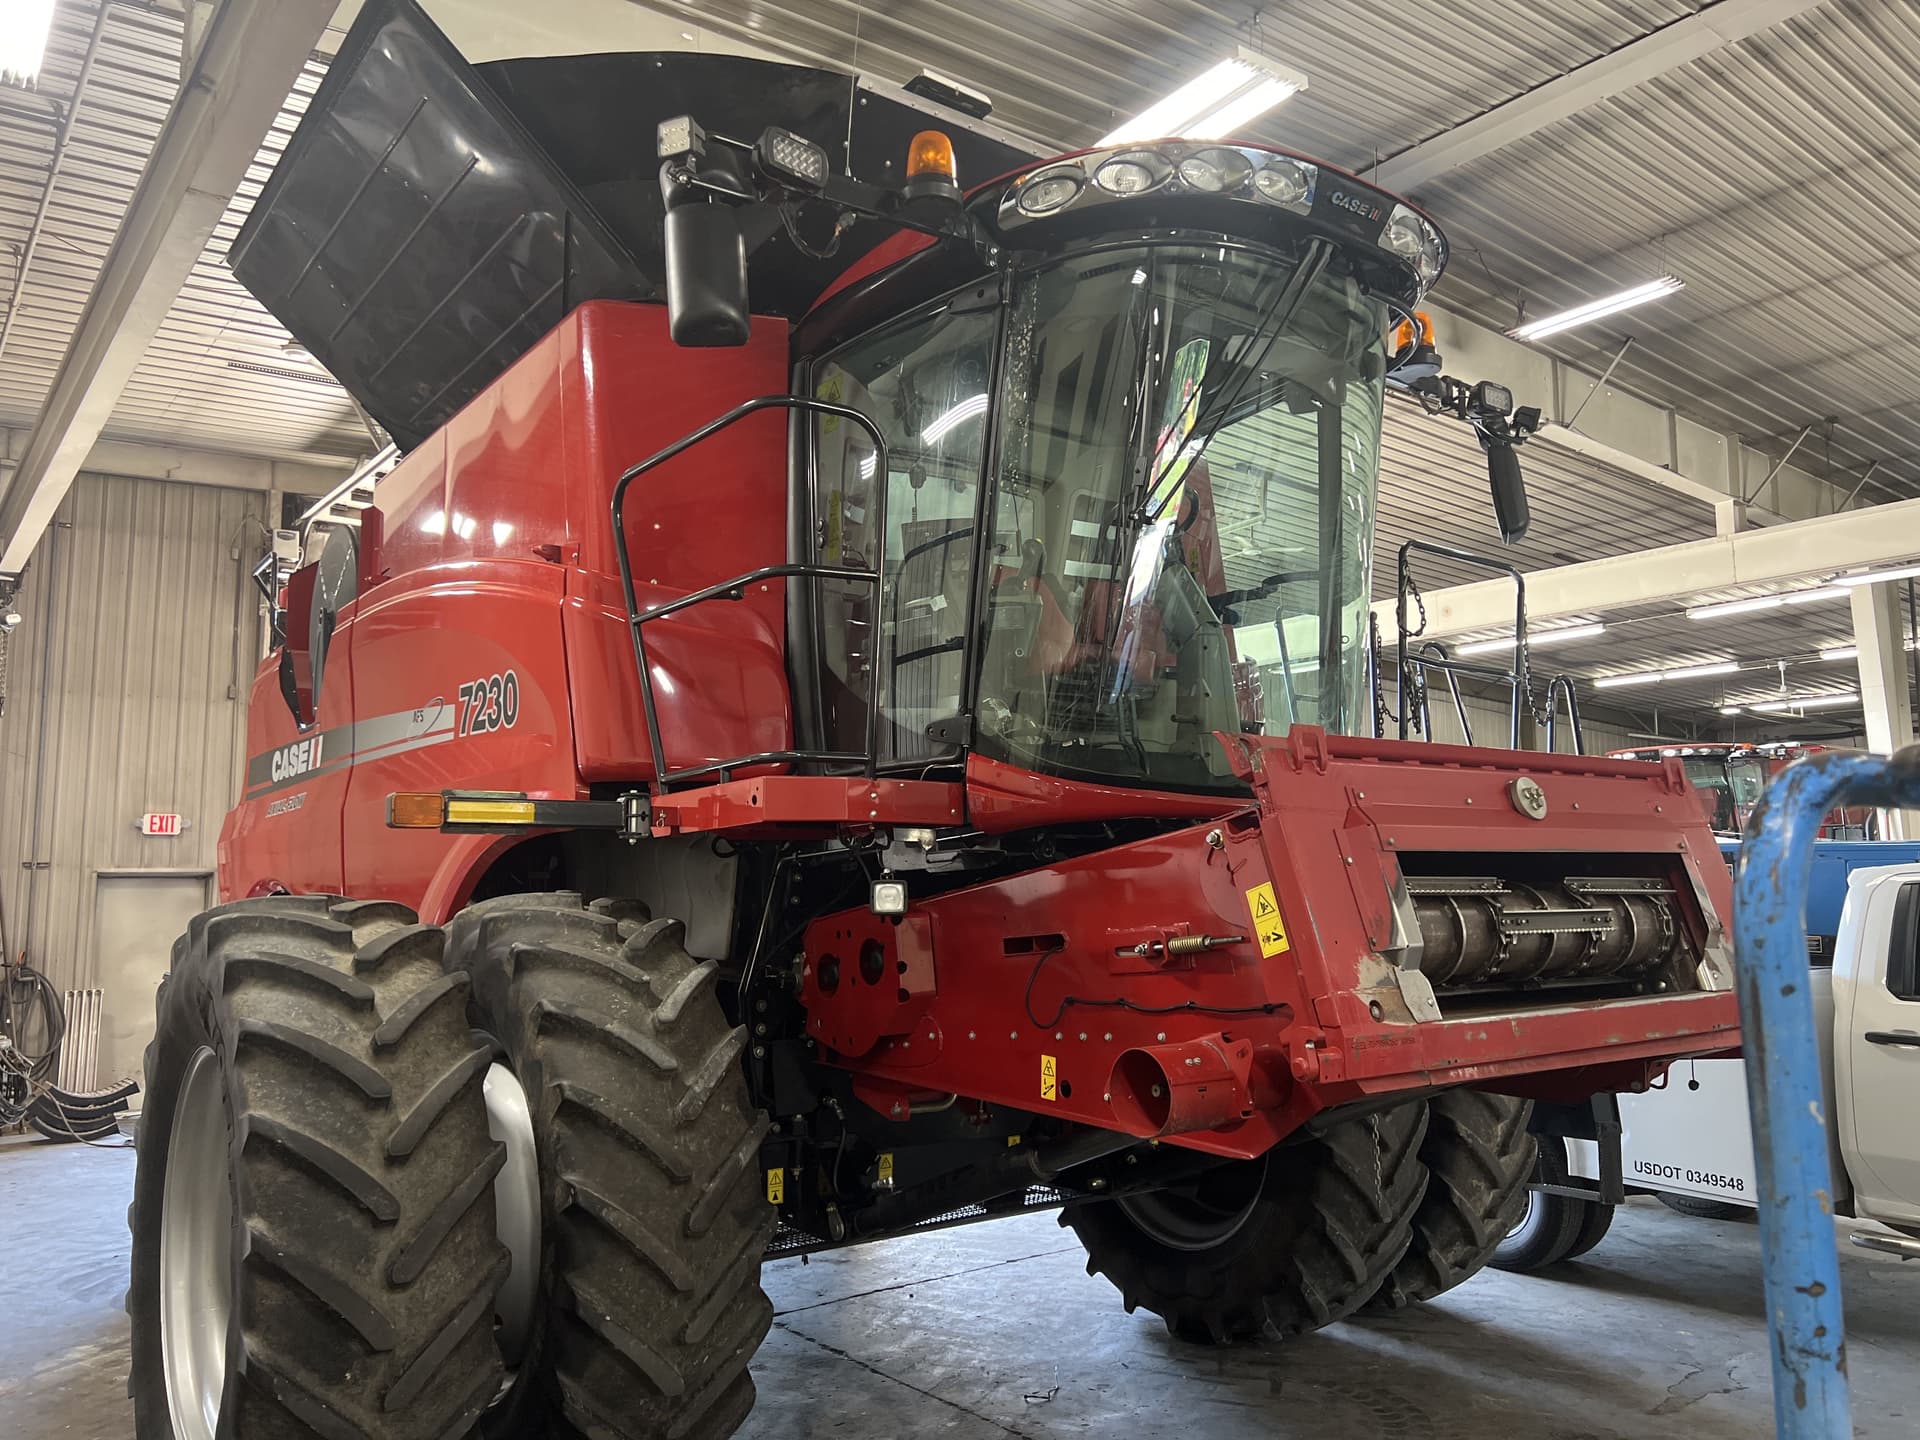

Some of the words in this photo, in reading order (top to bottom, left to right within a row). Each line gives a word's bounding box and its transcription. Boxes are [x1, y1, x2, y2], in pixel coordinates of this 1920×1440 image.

[458, 669, 519, 738] 7230
[149, 815, 176, 833] EXIT
[1634, 1160, 1682, 1180] USDOT
[1686, 1169, 1744, 1192] 0349548
